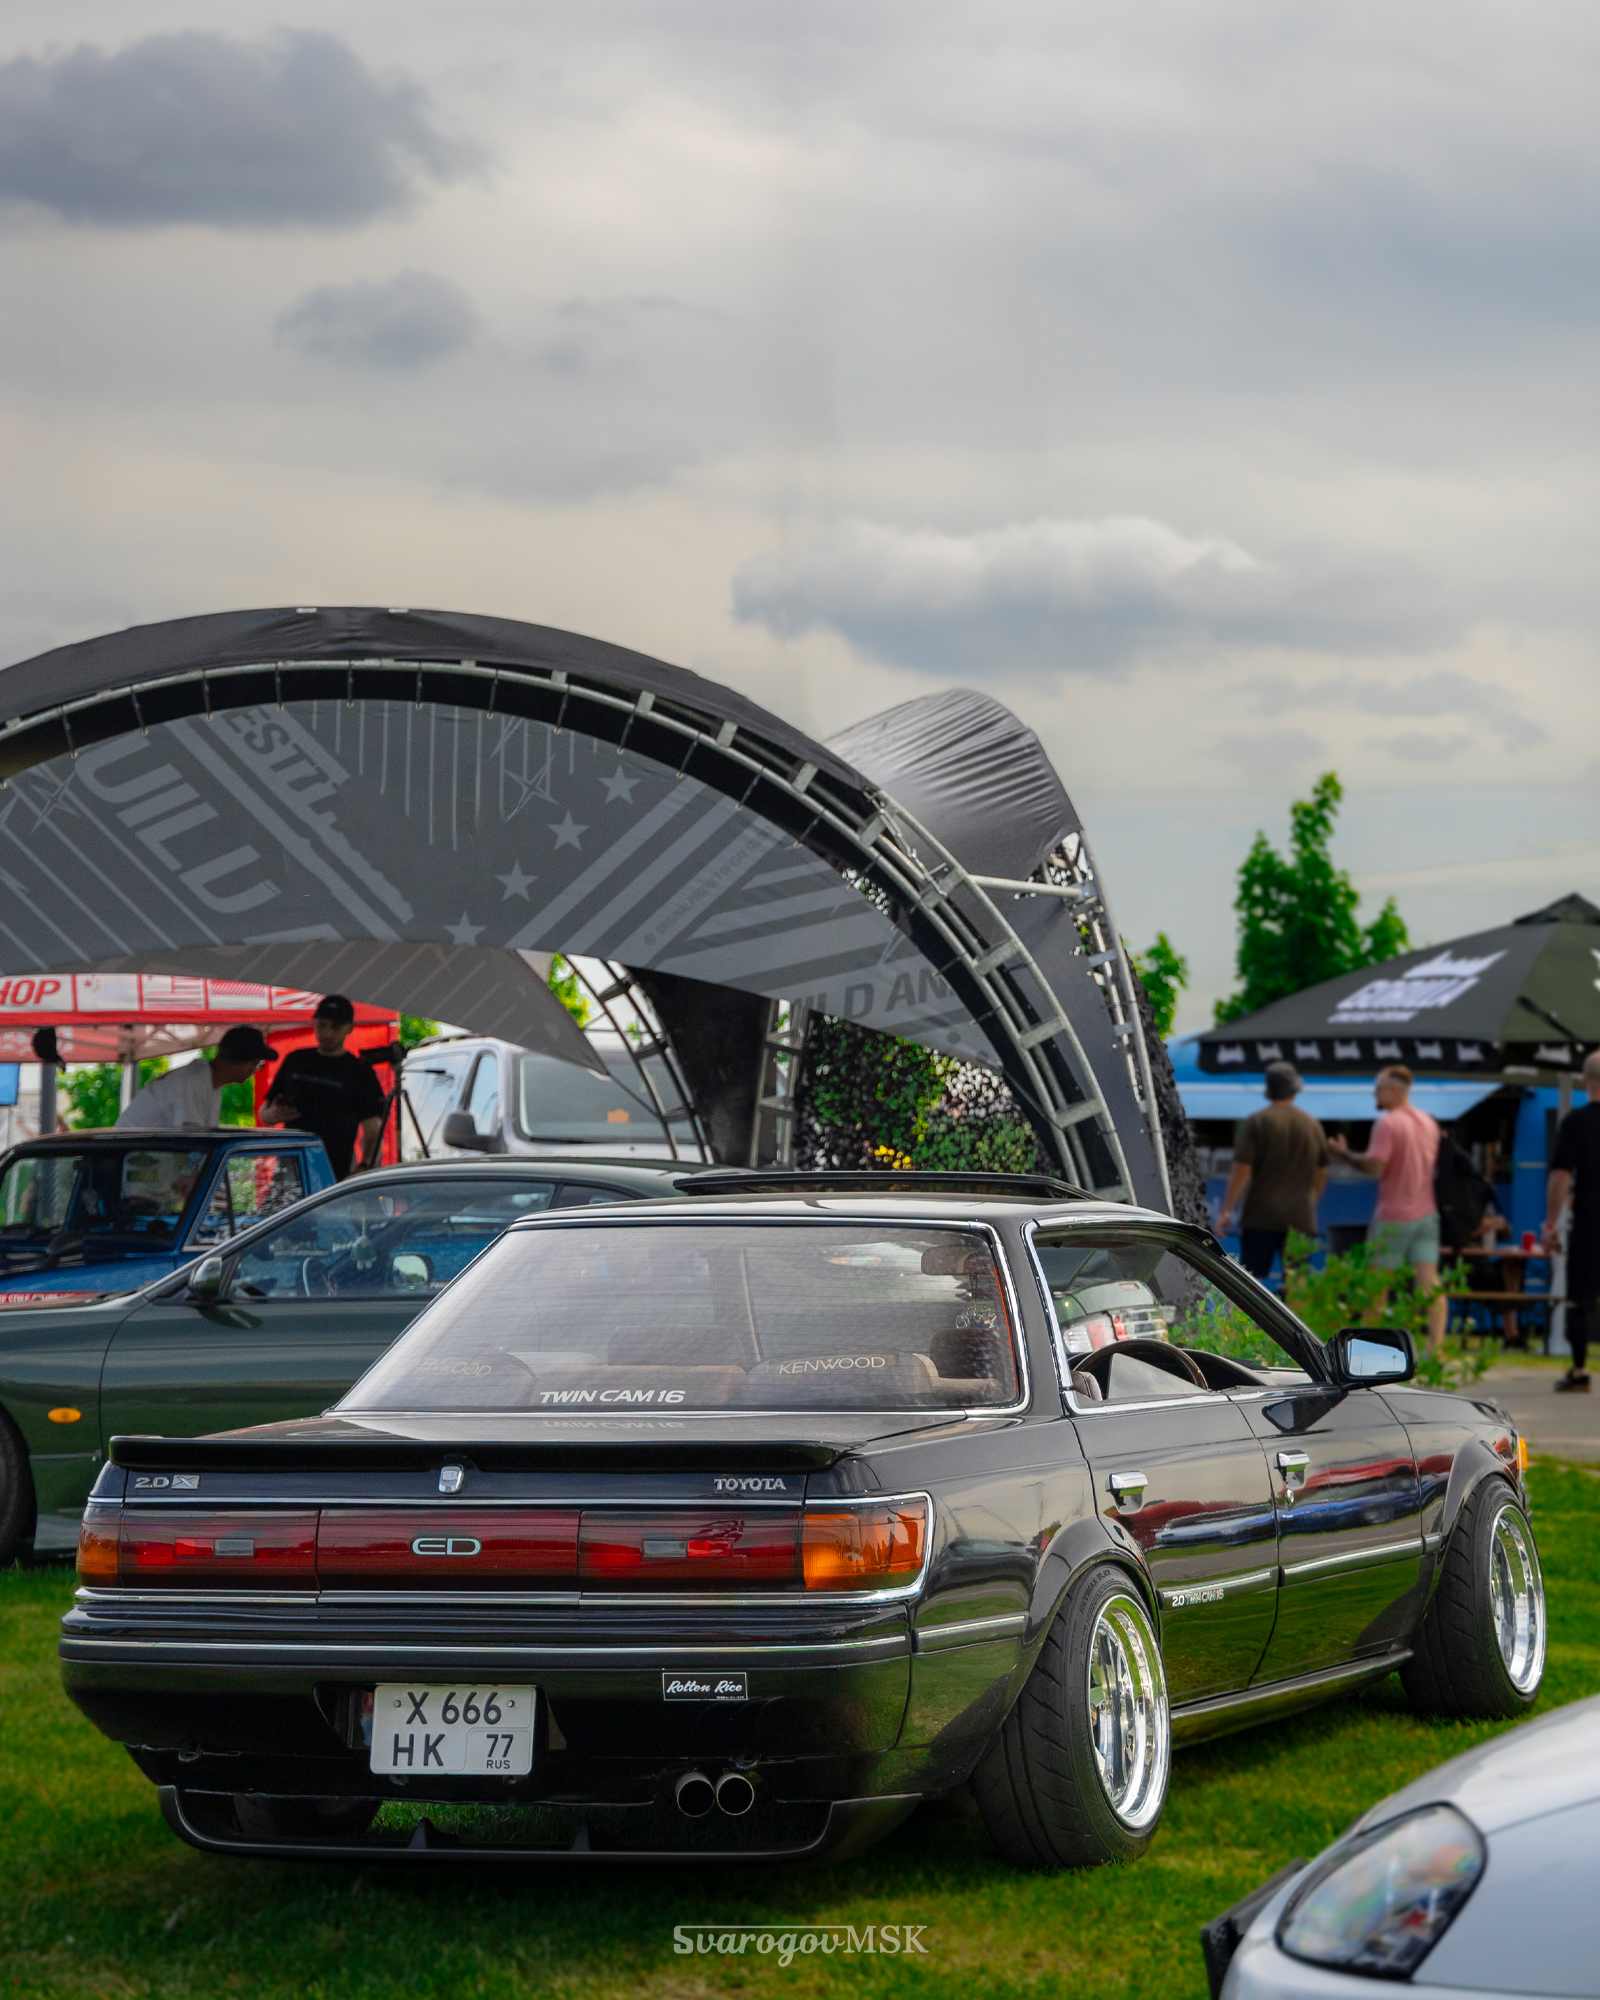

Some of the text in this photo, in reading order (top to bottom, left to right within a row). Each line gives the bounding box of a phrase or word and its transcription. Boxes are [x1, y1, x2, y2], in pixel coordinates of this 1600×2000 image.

[779, 1356, 886, 1375] KENWOOD
[539, 1389, 686, 1403] TWIN CAM 16
[714, 1478, 786, 1491] TOYOTA
[412, 1538, 481, 1556] ED
[666, 1680, 711, 1693] Rotten
[442, 1691, 501, 1724] 666
[486, 1733, 514, 1758] 77
[486, 1760, 511, 1769] RUS
